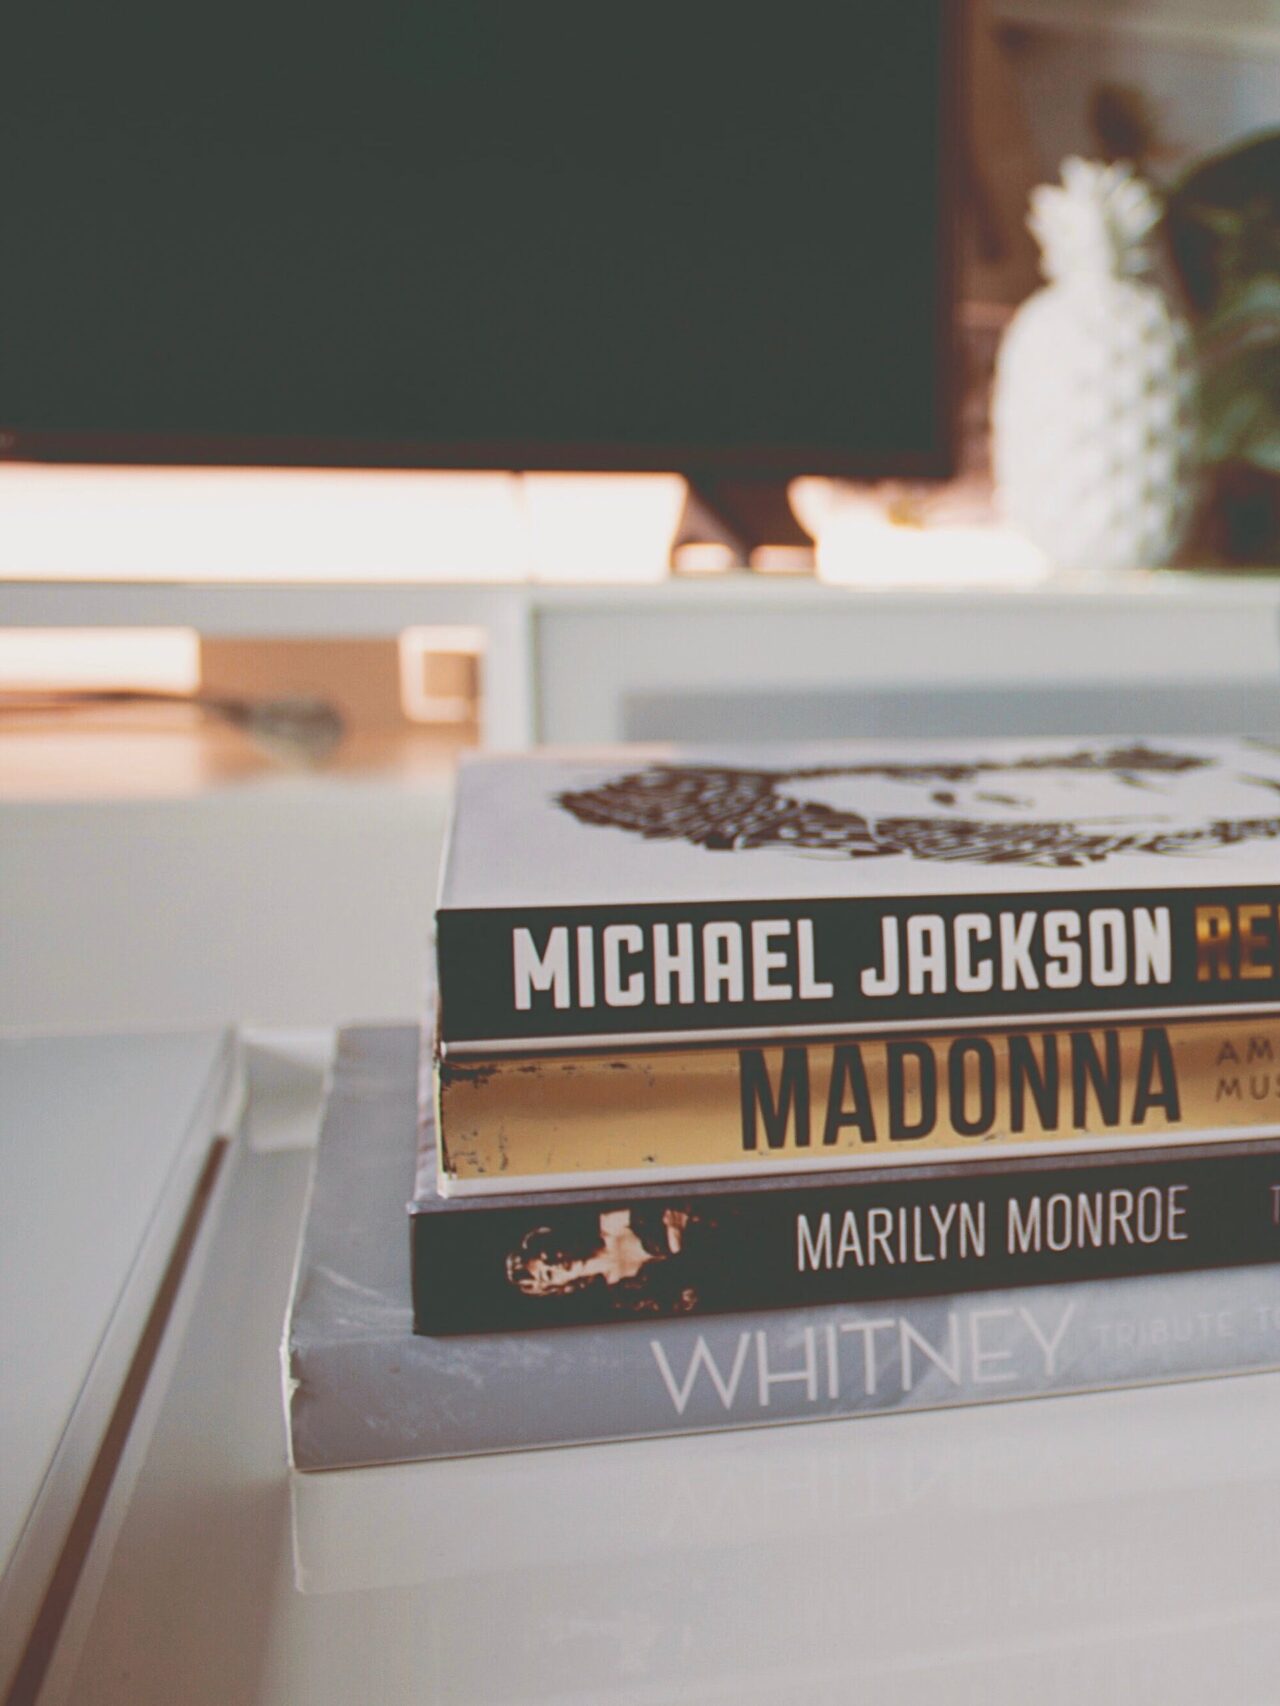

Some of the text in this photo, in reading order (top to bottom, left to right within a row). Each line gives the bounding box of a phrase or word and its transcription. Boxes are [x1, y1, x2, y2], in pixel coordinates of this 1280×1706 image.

[512, 918, 834, 1011] MICHAEL
[860, 906, 1172, 997] JACKSON
[737, 1026, 1183, 1151] MADONNA
[796, 1200, 986, 1273] MARILYN
[1007, 1184, 1190, 1255] MONROE
[649, 1302, 1076, 1416] WHITNEY
[1093, 1312, 1234, 1350] TRIBUTE
